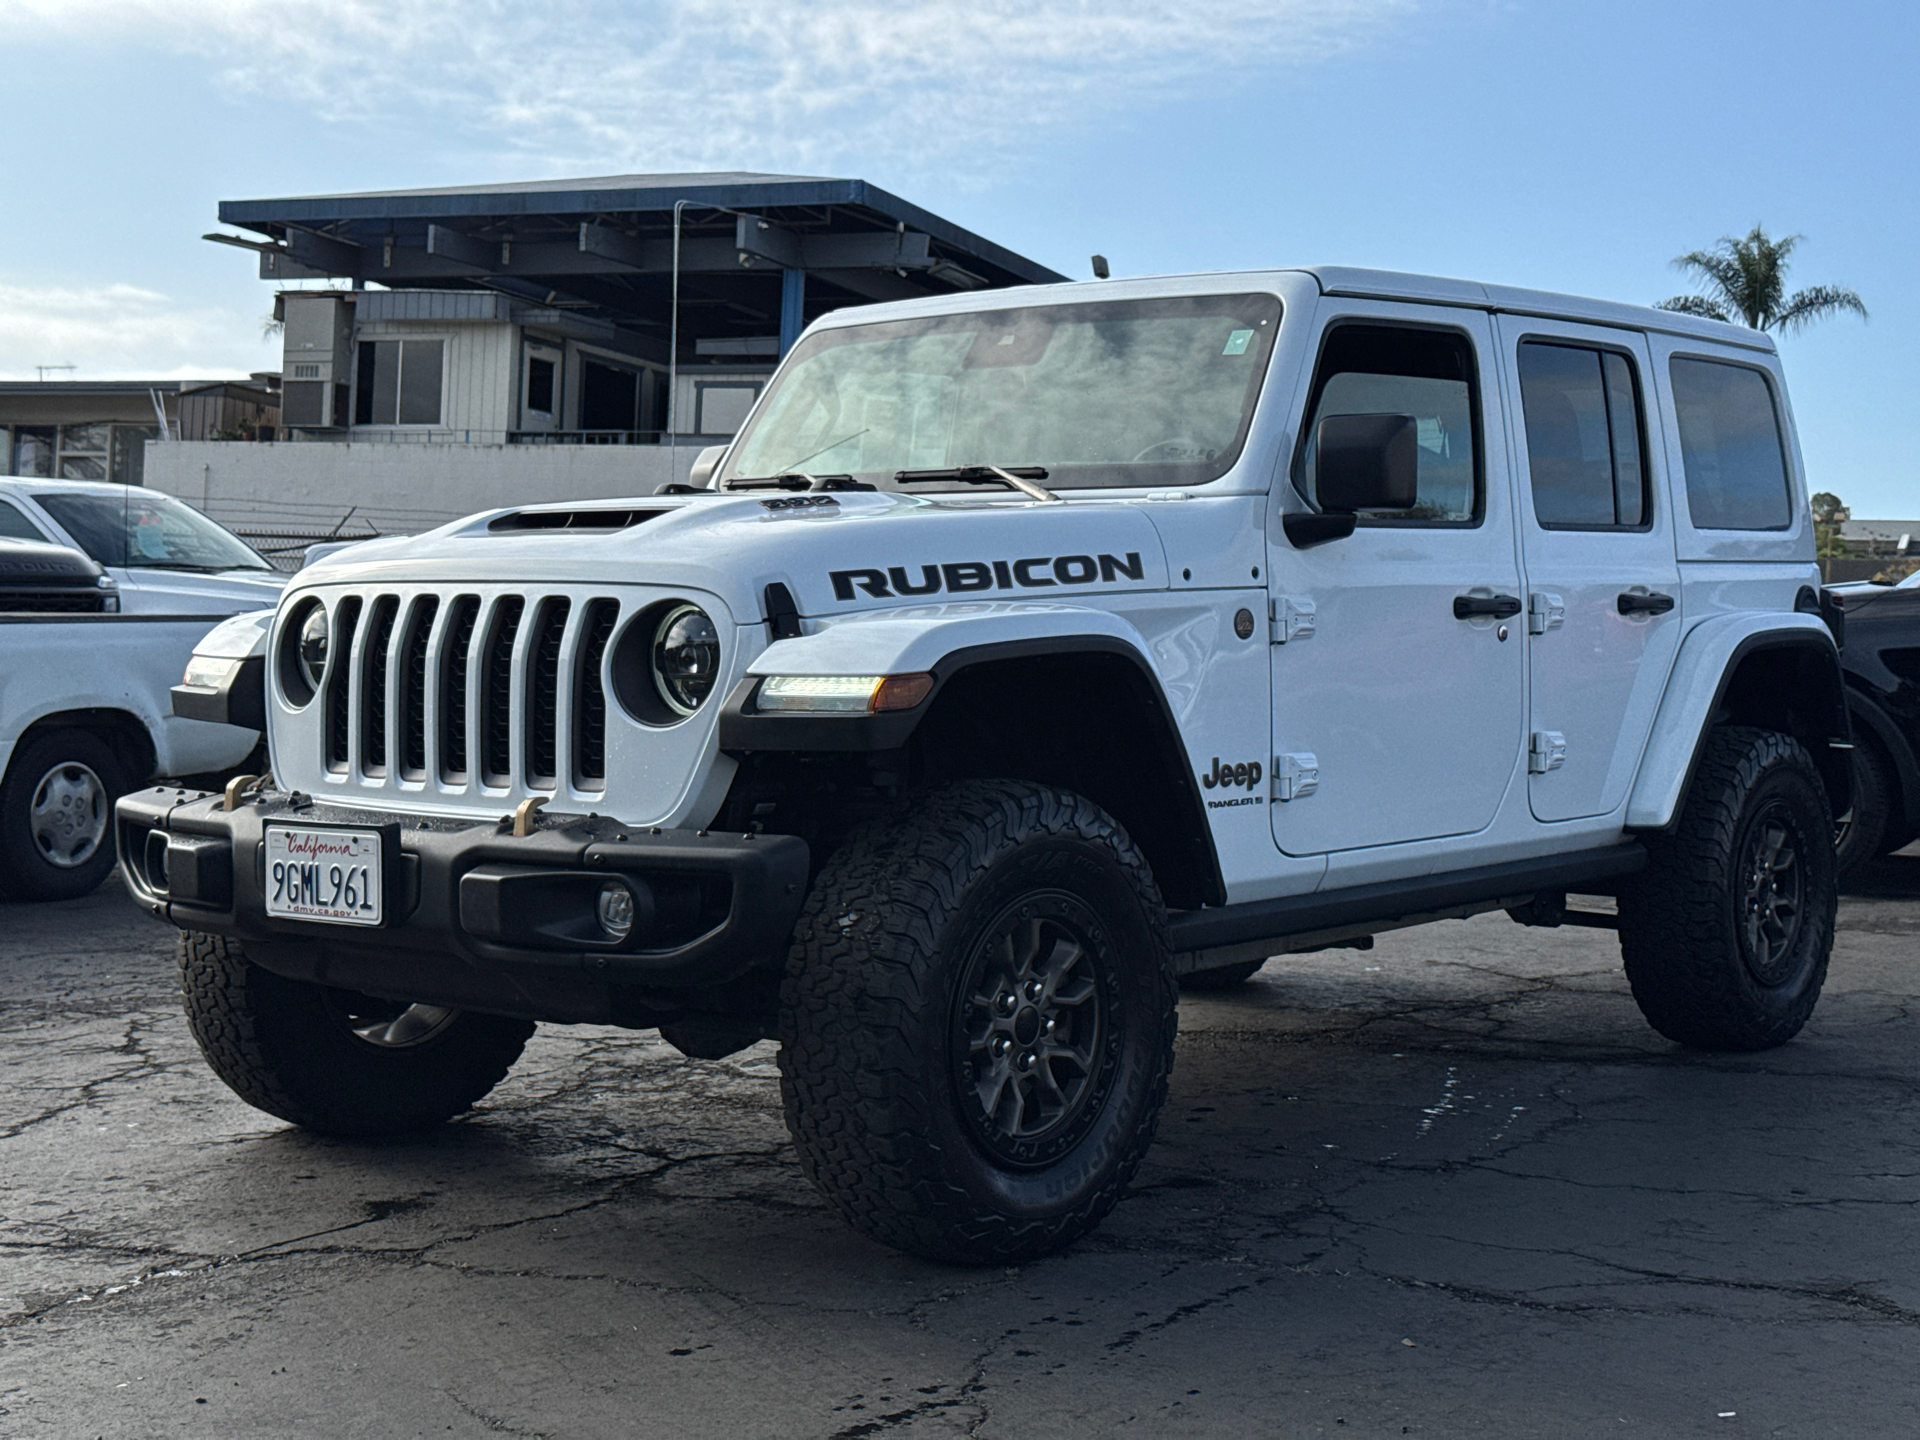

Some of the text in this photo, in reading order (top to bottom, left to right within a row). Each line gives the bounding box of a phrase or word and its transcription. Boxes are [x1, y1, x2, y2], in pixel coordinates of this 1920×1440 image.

[828, 551, 1145, 601] RUBICON
[1202, 756, 1263, 792] Jeep
[287, 832, 359, 860] California
[272, 858, 373, 910] 9GML961
[293, 905, 352, 917] dmv.ca.gov
